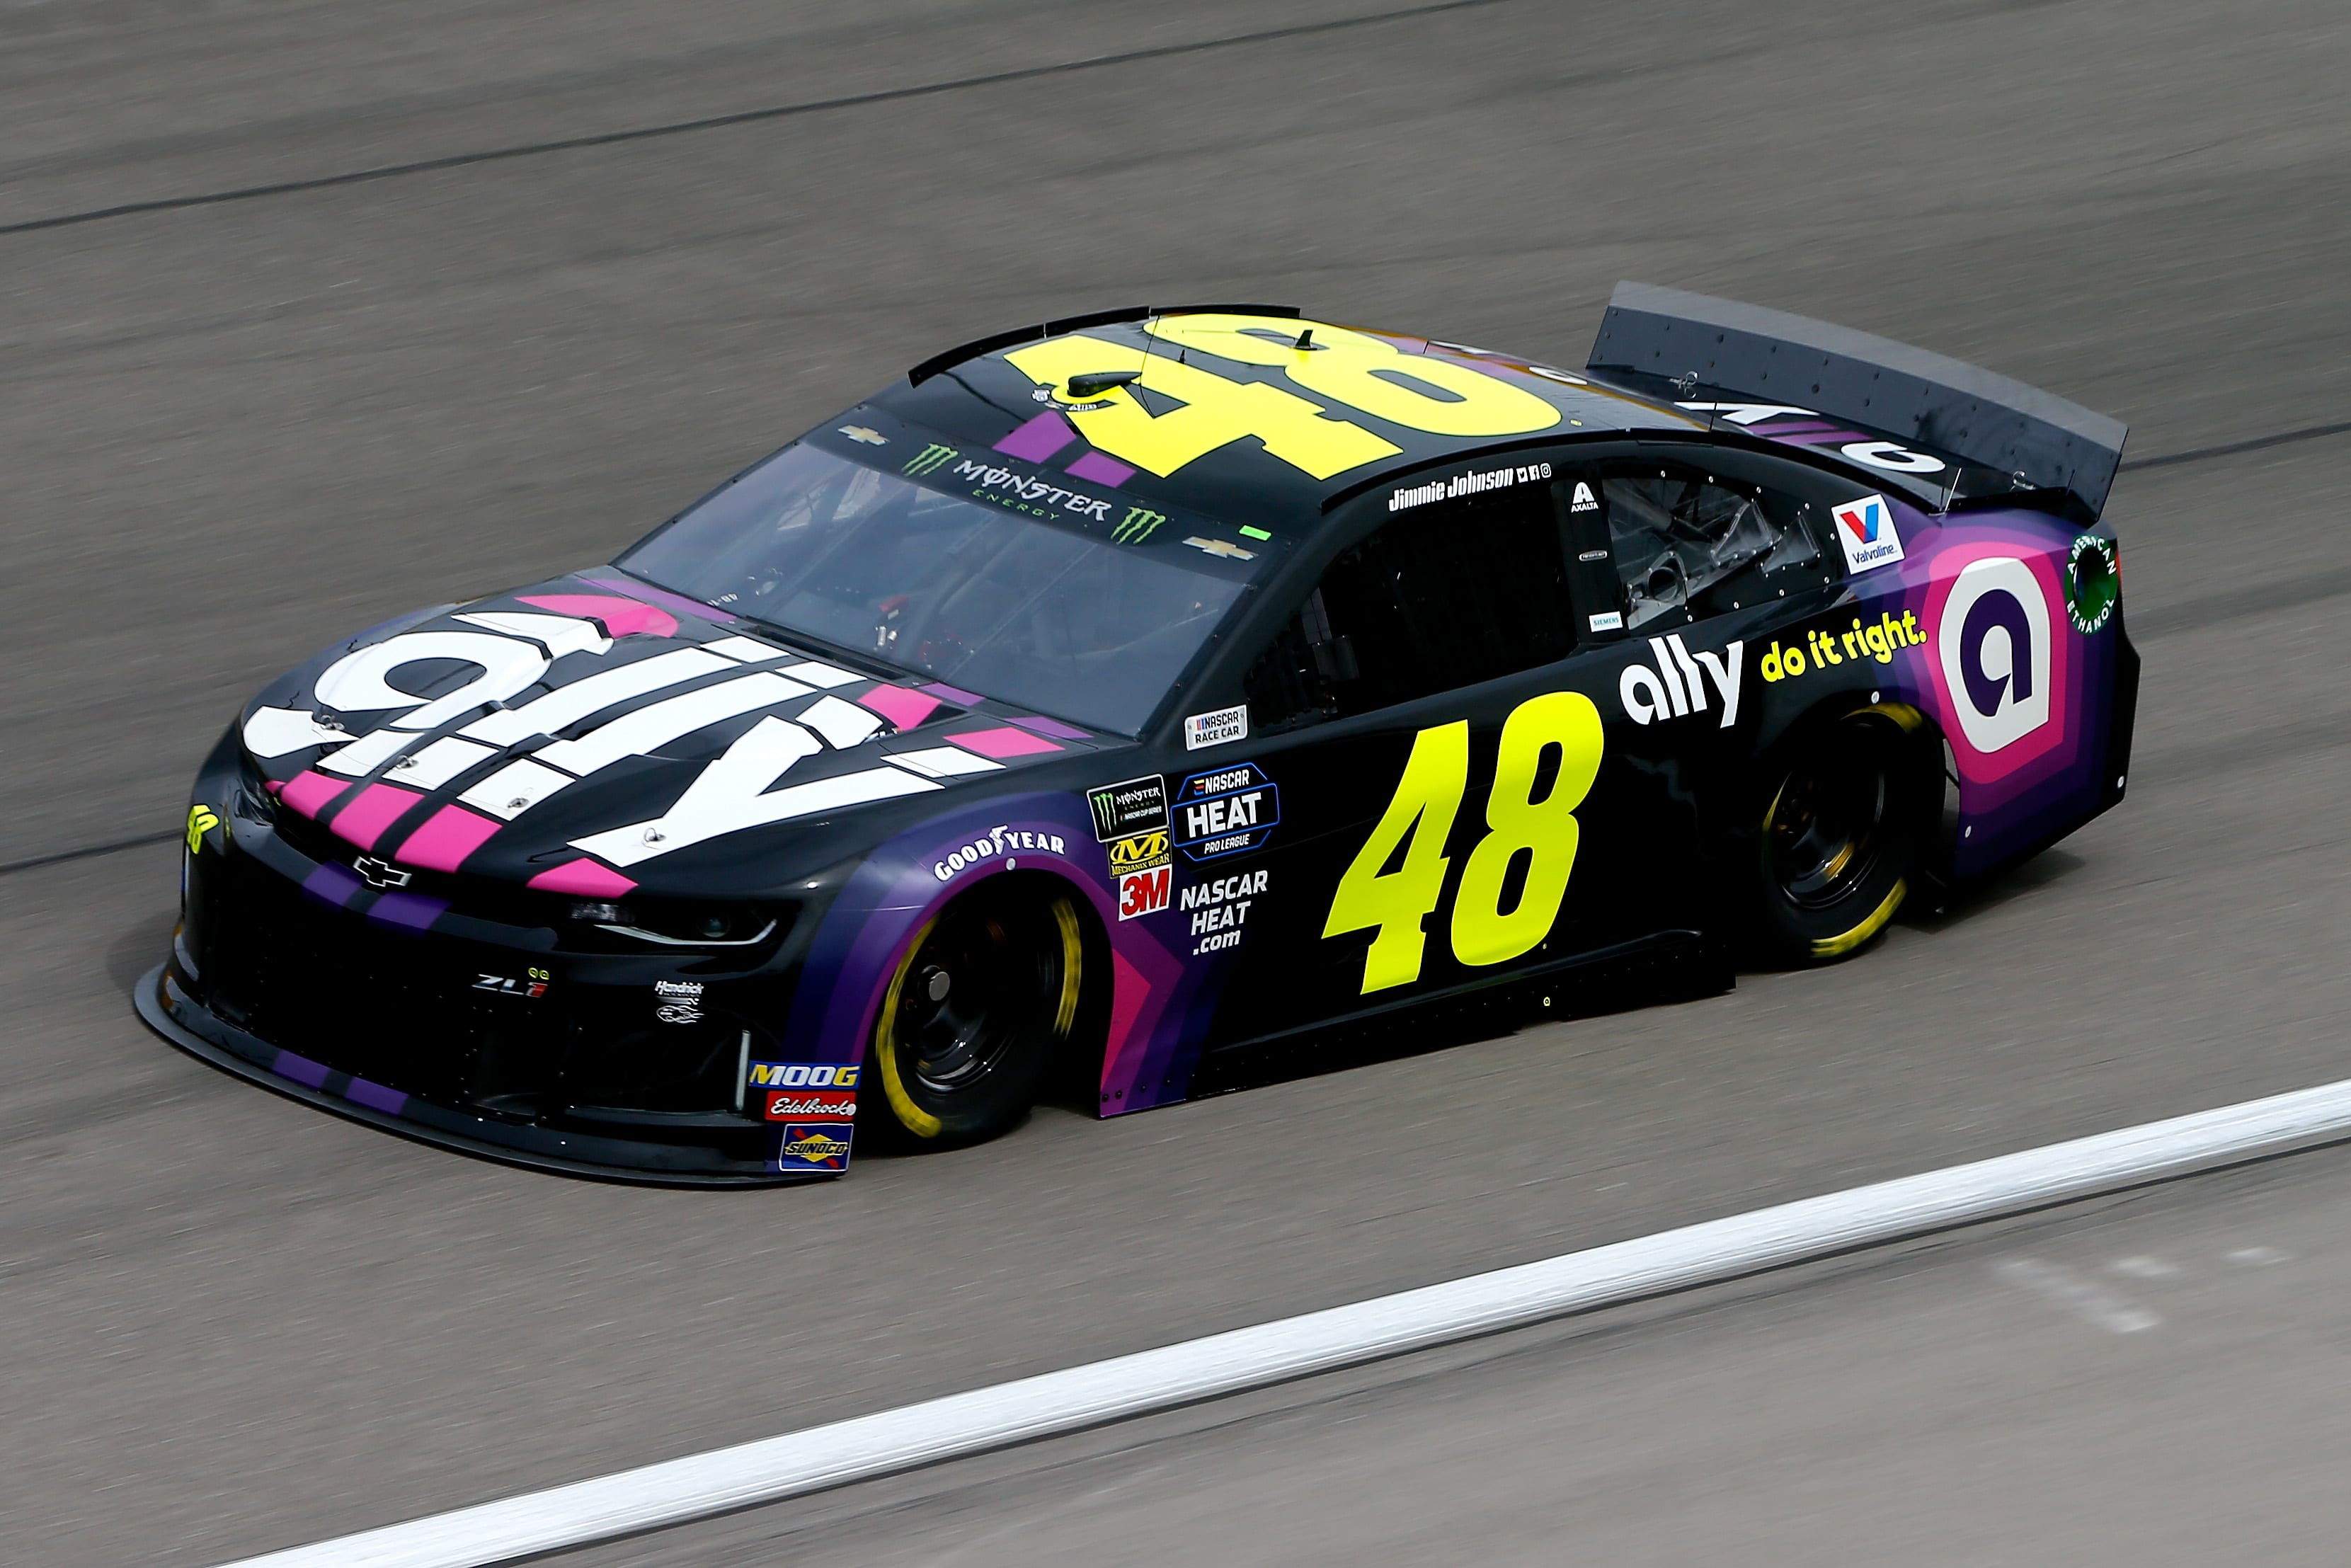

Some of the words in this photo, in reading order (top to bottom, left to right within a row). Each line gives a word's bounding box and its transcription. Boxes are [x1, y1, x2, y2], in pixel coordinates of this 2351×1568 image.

[1003, 313, 1562, 481] 48
[972, 488, 1059, 520] ENERGY
[1388, 480, 1446, 512] Jimmie
[1447, 469, 1514, 498] Johnson
[1571, 501, 1598, 513] AXALTA
[1852, 544, 1894, 564] Valvoline
[2066, 535, 2117, 575] AMERICAN
[1593, 617, 1620, 626] SIEMENS
[1761, 641, 1806, 682] do
[1807, 630, 1843, 669] it
[1841, 610, 1928, 664] right.
[1619, 634, 1744, 728] ally
[1205, 711, 1239, 728] NASCAR
[1195, 731, 1219, 743] RACE
[1221, 726, 1240, 737] CAR
[1205, 769, 1249, 794] NASCAR
[1186, 791, 1262, 838] HEAT
[934, 825, 1065, 881] GOODYEAR
[1204, 840, 1219, 854] PRO
[1221, 833, 1250, 850] LEAGUE
[1321, 691, 1604, 995] 48
[1111, 862, 1148, 876] MECHANIX
[1148, 852, 1170, 867] WEAR
[1121, 868, 1170, 916] 3M
[1179, 870, 1268, 911] NASCAR
[1191, 900, 1252, 936] HEAT
[1193, 929, 1241, 956] .com
[654, 980, 704, 995] Hendrick
[749, 1064, 860, 1086] MOOG
[770, 1097, 851, 1116] Edelbrock
[786, 1143, 848, 1155] SUNOCO
